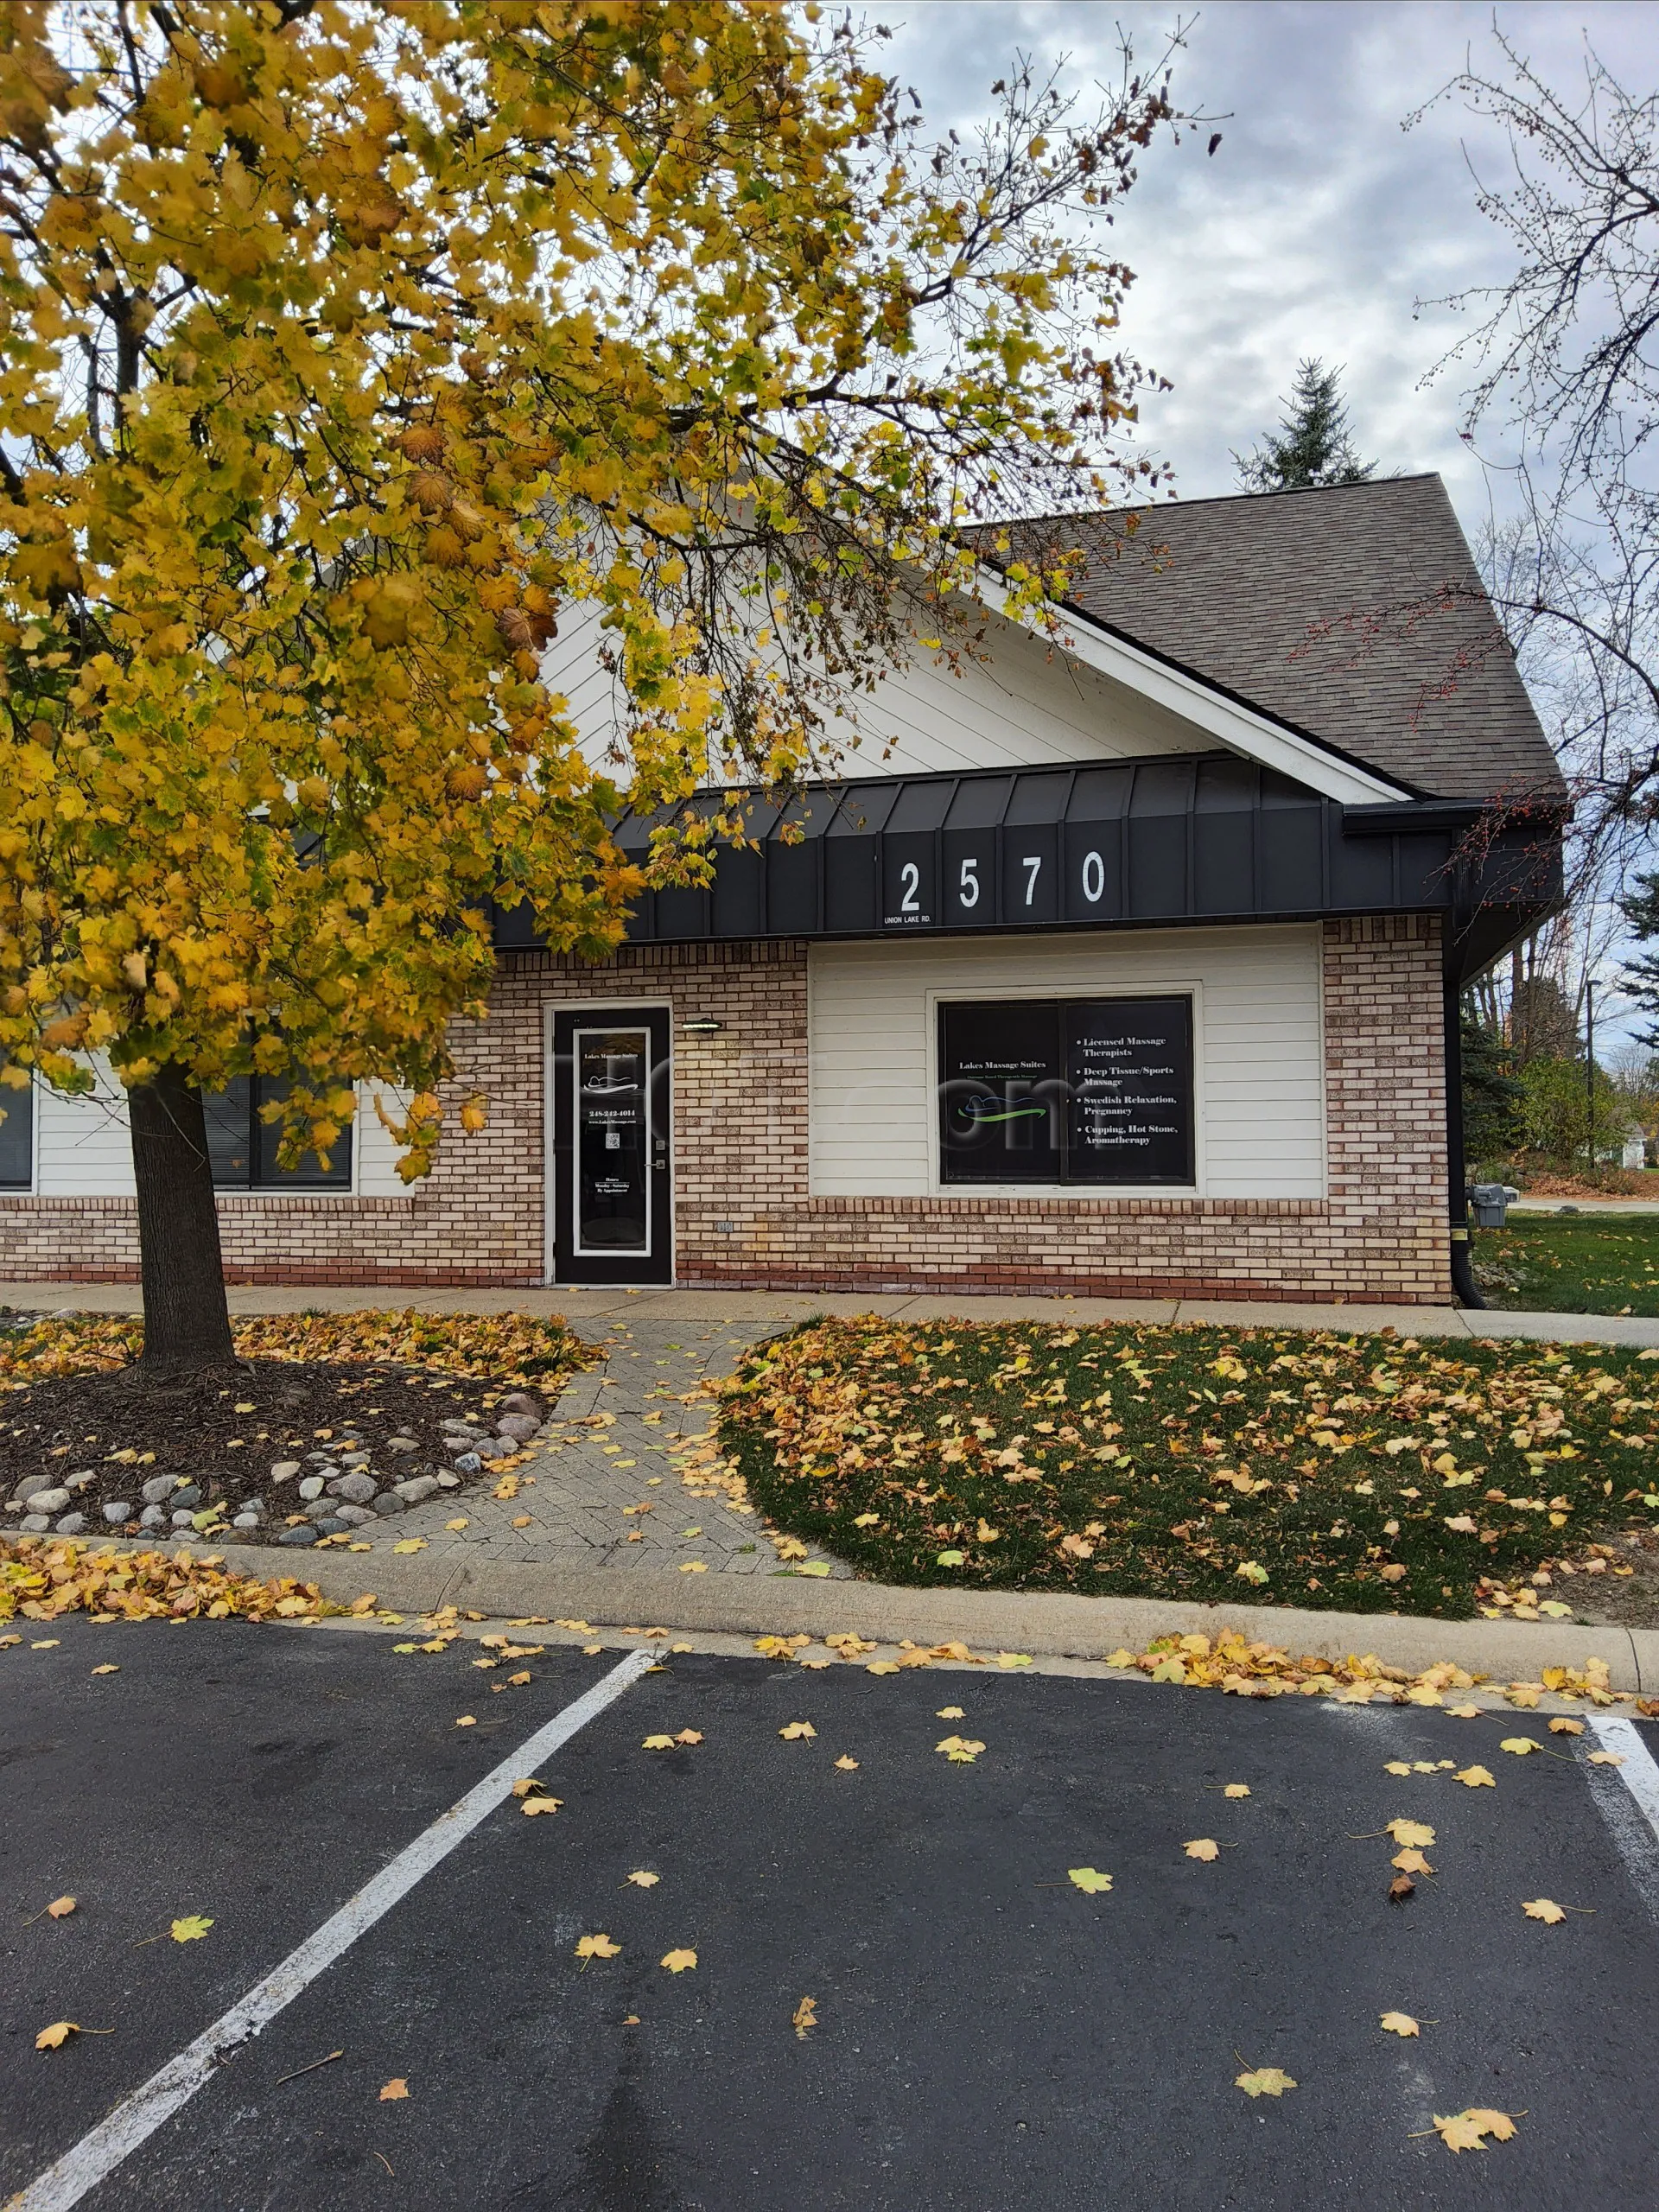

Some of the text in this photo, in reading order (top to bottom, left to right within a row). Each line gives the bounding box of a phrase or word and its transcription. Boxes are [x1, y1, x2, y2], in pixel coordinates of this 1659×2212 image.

[1083, 1037, 1166, 1046] Licensed Massage
[1083, 1048, 1133, 1058] Therapists
[959, 1060, 1046, 1071] Lakes Massage Suites
[1084, 1066, 1174, 1077] Deep Tissue/Sports
[1084, 1078, 1123, 1088] Massage
[1084, 1095, 1177, 1104] Swedish Relaxation,
[1084, 1107, 1133, 1116] Pregnancy
[1084, 1124, 1179, 1135] Cupping, Hot Stone,
[1084, 1135, 1151, 1146] Aromatherapy
